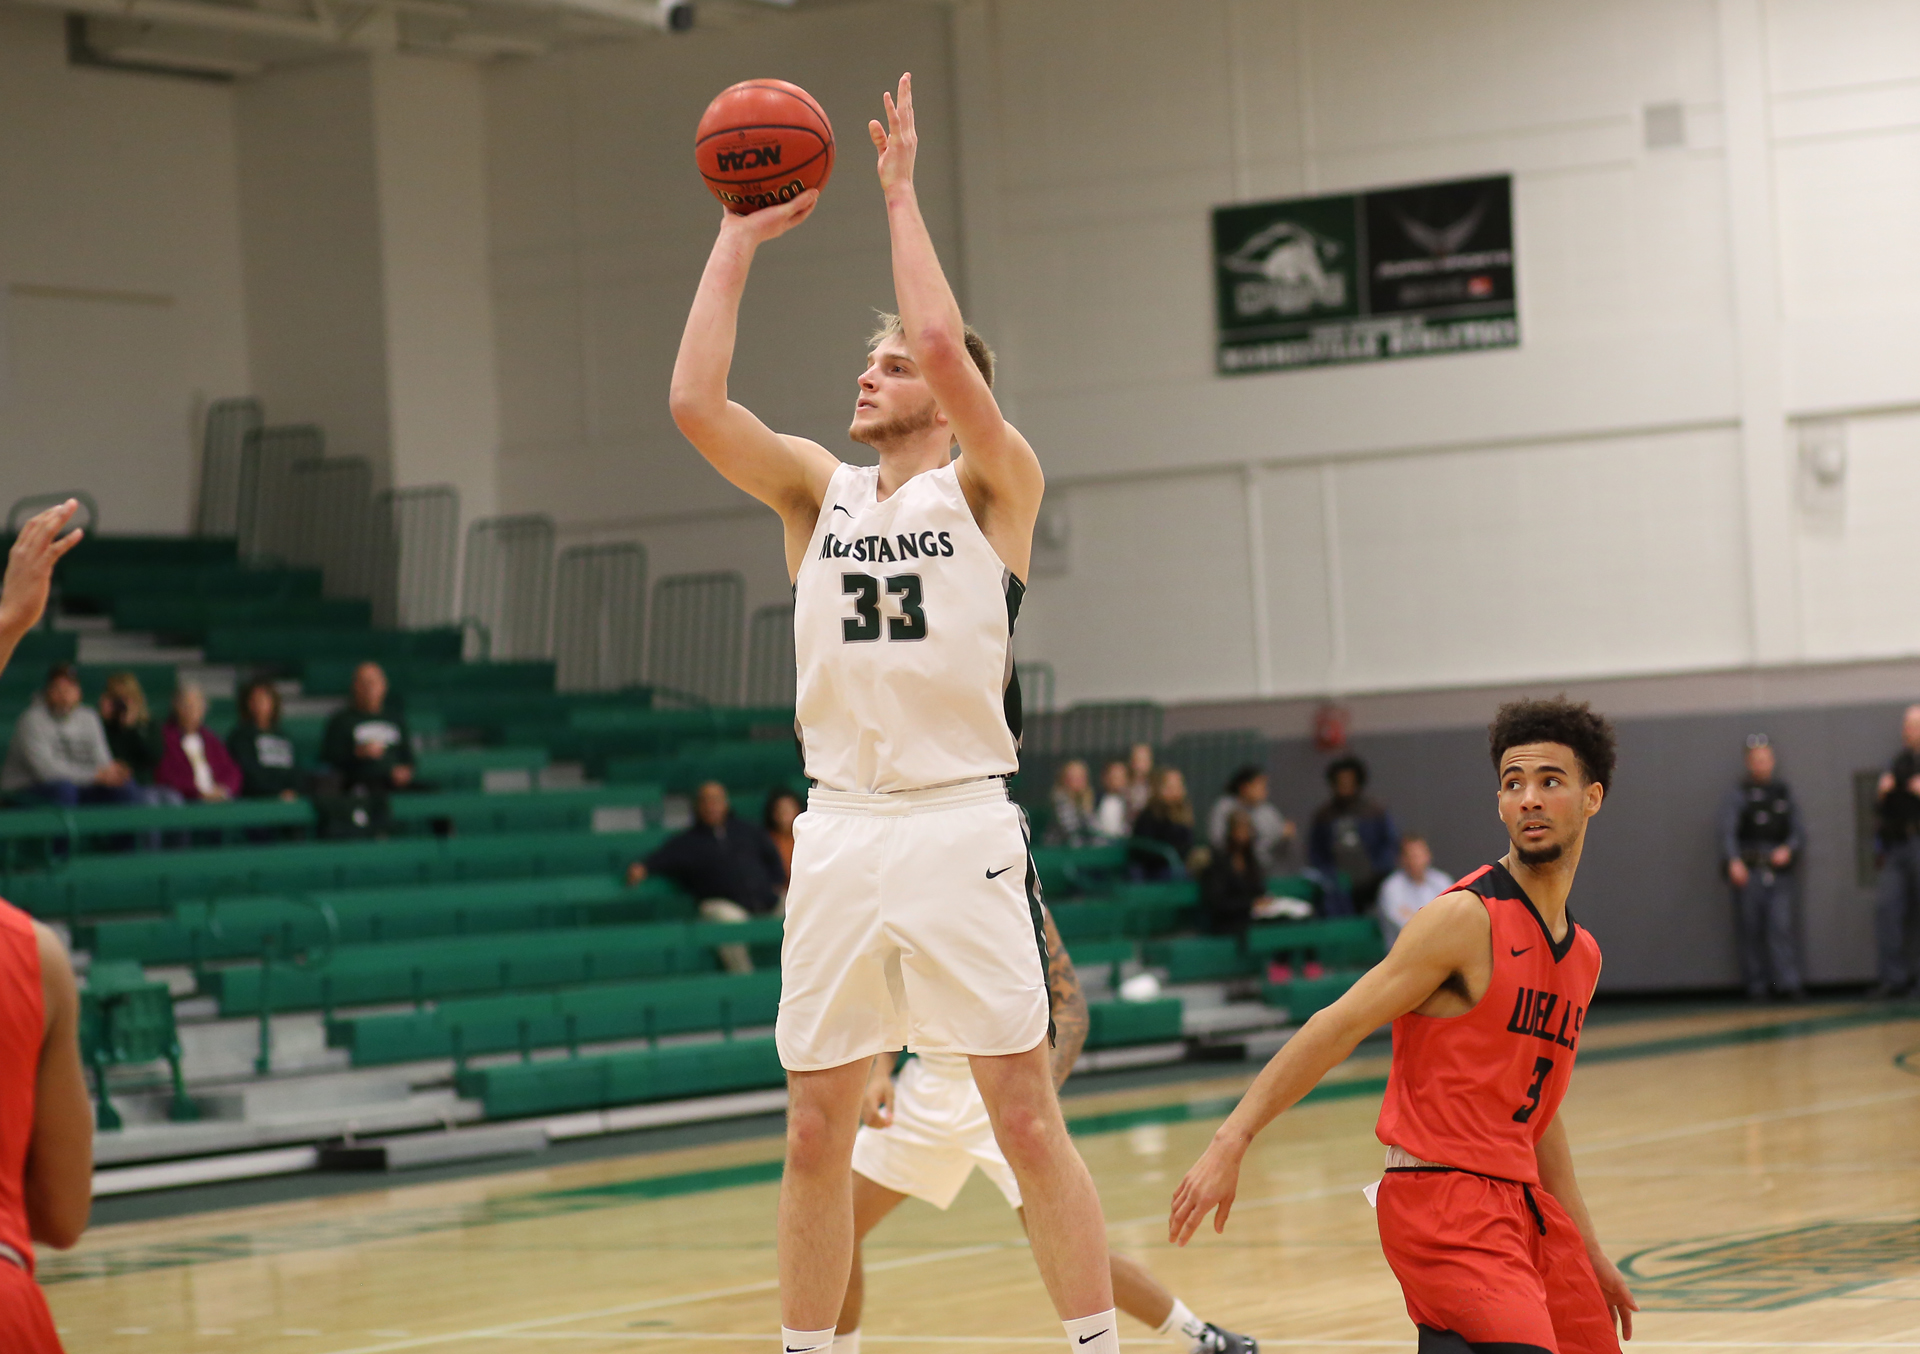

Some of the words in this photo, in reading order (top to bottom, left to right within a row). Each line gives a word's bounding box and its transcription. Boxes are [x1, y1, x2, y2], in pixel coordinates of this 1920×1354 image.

[716, 145, 782, 172] NCAA
[818, 531, 955, 563] MUSTANGS
[841, 571, 929, 644] 33
[1506, 986, 1584, 1051] WELLS
[1511, 1056, 1554, 1124] 3
